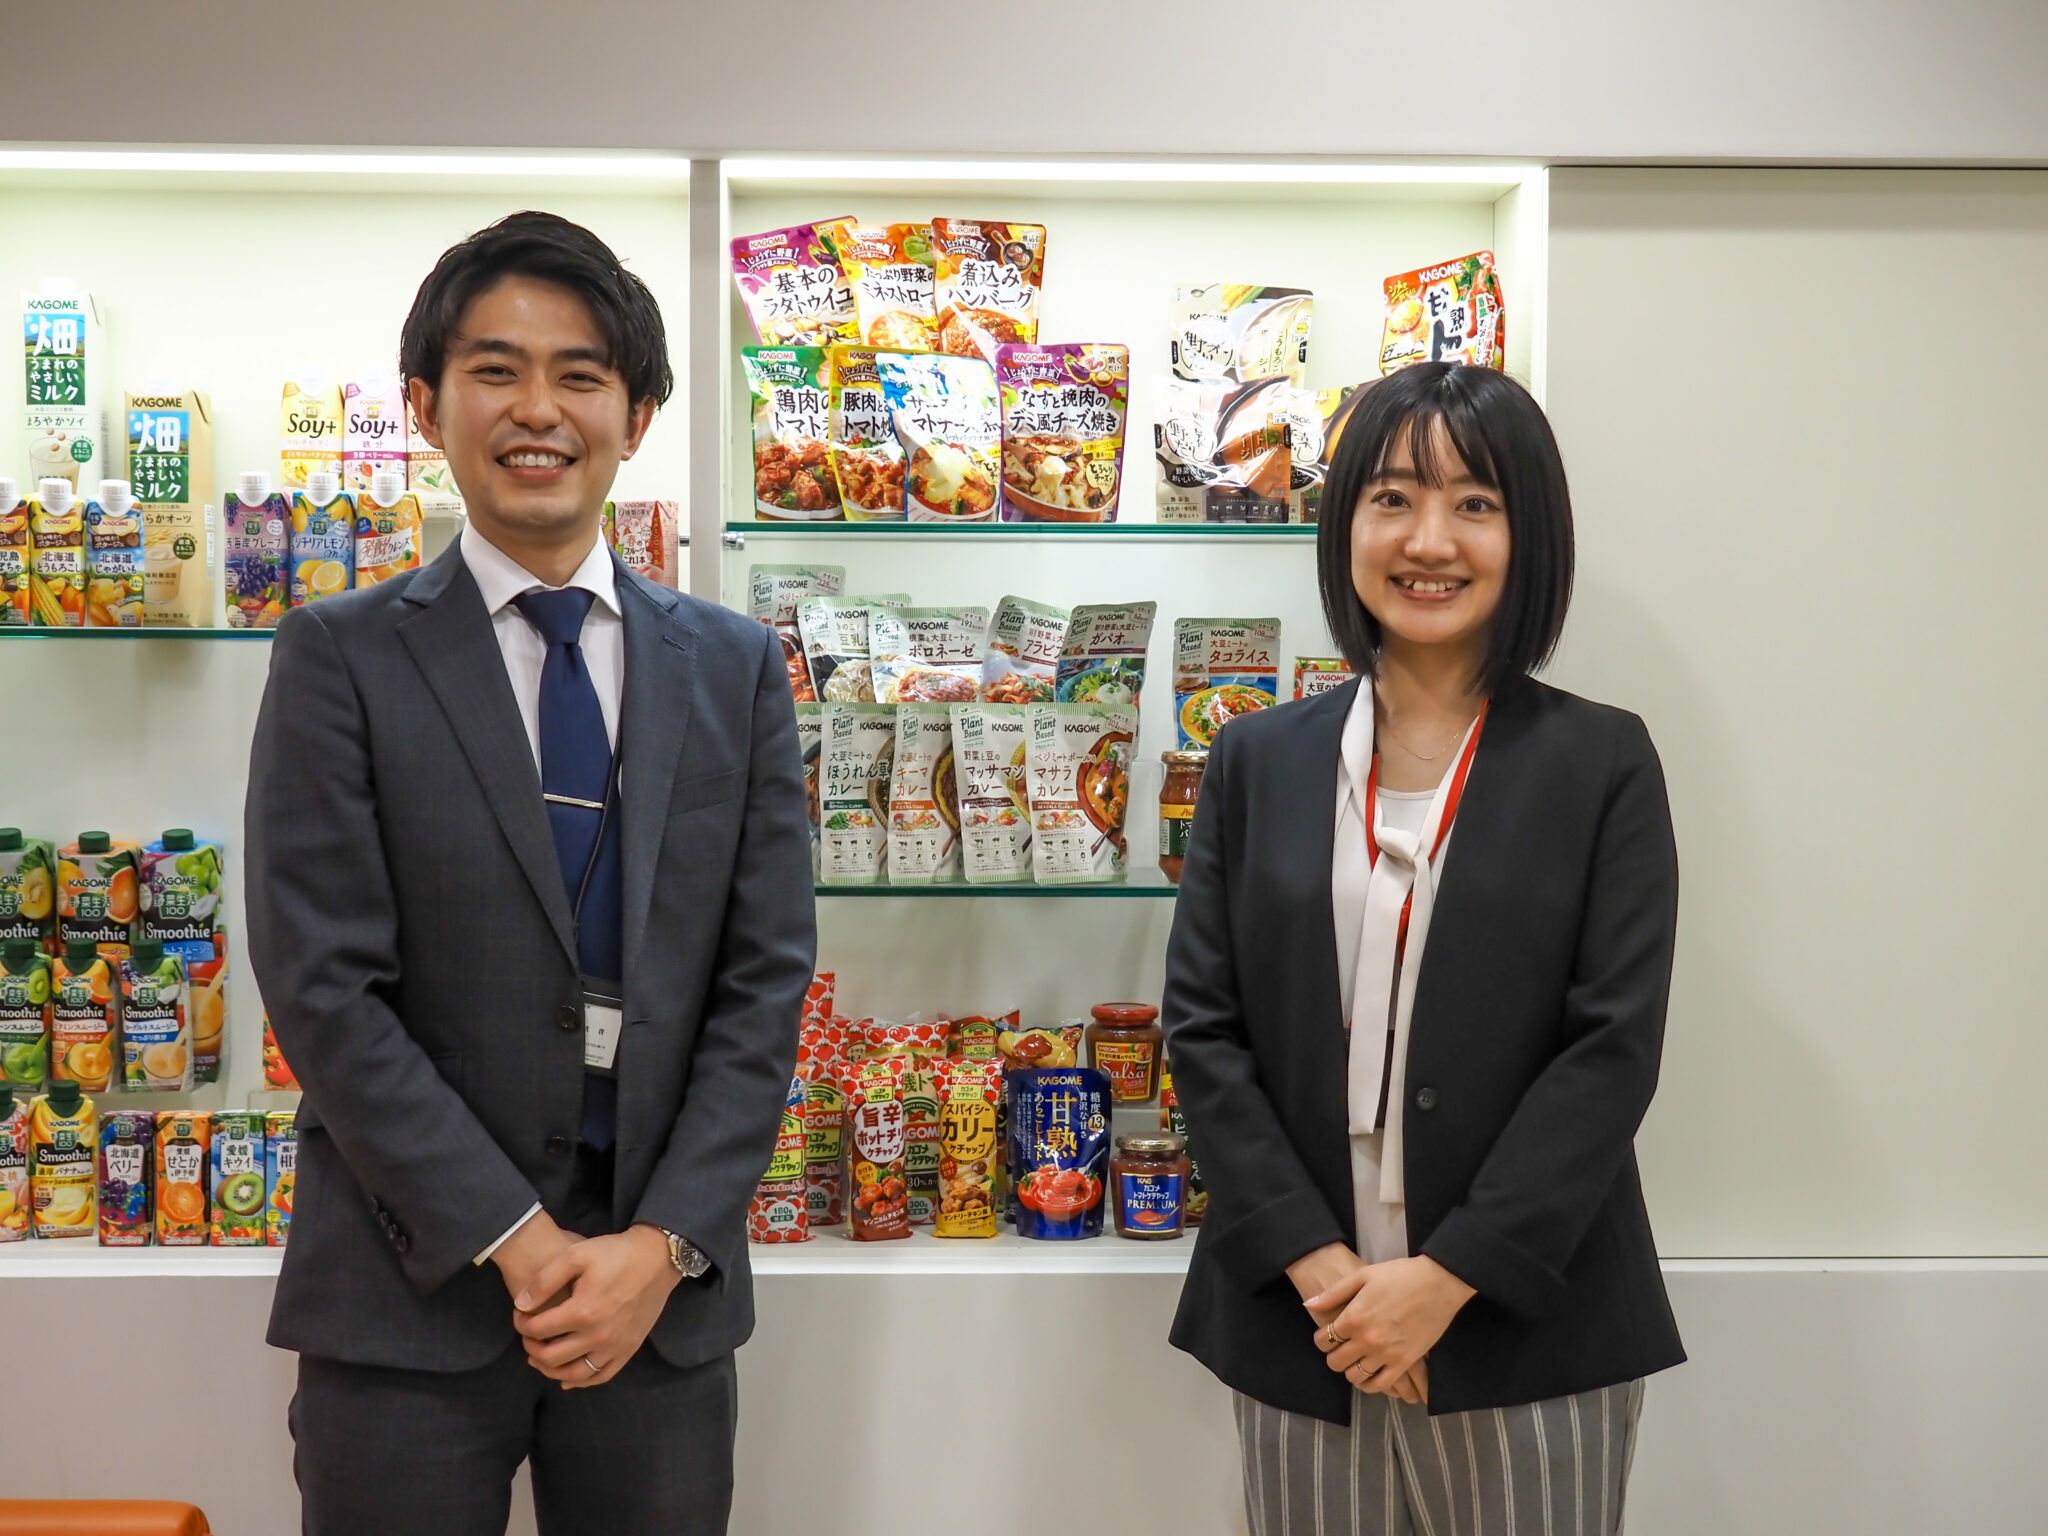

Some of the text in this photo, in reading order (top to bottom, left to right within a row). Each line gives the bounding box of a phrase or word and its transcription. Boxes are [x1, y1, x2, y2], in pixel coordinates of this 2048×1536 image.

[948, 225, 980, 235] KAGOME
[750, 235, 786, 249] KAGOME
[961, 262, 1020, 288] 煮込み
[1418, 262, 1464, 283] KAGOME
[775, 267, 834, 294] 基本の
[861, 281, 934, 305] ミネストロー
[948, 287, 1034, 308] ハンバーグ
[28, 300, 78, 310] KAGOME
[30, 315, 78, 356] 畑
[759, 352, 795, 360] KAGOME
[1014, 354, 1052, 362] KAGOME
[31, 359, 78, 370] うまれの
[30, 372, 79, 383] やさしい
[31, 385, 79, 401] ミルク
[1021, 388, 1106, 409] なすと挽肉の
[132, 398, 182, 408] KAGOME
[287, 413, 337, 439] Soy+
[775, 412, 829, 438] トマト
[1010, 408, 1118, 432] デミ風チーズ焼き
[349, 414, 399, 439] Soy+
[134, 413, 181, 454] 畑
[135, 457, 181, 468] うまれの
[135, 470, 182, 481] やさしい
[135, 483, 182, 498] ミルク
[143, 515, 192, 525] らかオーツ
[43, 552, 75, 562] 北海道
[100, 553, 133, 564] 北海道
[37, 562, 81, 573] とうもろこし
[95, 564, 137, 574] じゃがいも
[753, 583, 773, 598] Plant
[779, 580, 809, 589] KAGOME
[754, 596, 772, 606] Based
[1000, 611, 1026, 624] Plant
[1072, 616, 1093, 630] Plant
[1097, 613, 1125, 621] KAGOME
[908, 621, 949, 630] KAGOME
[999, 622, 1022, 632] Based
[1030, 616, 1063, 631] KAGOME
[1089, 632, 1125, 645] ガパオ
[1179, 631, 1204, 644] Plant
[1210, 639, 1249, 648] 大豆ミートの
[908, 644, 976, 659] ボロネーゼ
[1180, 643, 1202, 653] Based
[1209, 648, 1270, 664] タコライス
[1315, 674, 1347, 682] KAGOME
[832, 717, 853, 731] Plant
[859, 722, 896, 731] KAGOME
[902, 717, 919, 731] Plant
[960, 716, 984, 730] Plant
[991, 723, 1024, 733] KAGOME
[1033, 718, 1056, 731] Plant
[1064, 723, 1100, 733] KAGOME
[833, 729, 853, 739] Based
[963, 729, 984, 739] Based
[1035, 729, 1055, 740] Based
[829, 751, 873, 761] 大豆ミートの
[963, 750, 1001, 761] 野菜と豆の
[1034, 752, 1096, 763] ベジミートボールの
[827, 762, 891, 781] ほうれん草
[896, 766, 929, 778] キーマ
[965, 764, 1026, 779] マッサマン
[1033, 765, 1073, 781] マサラ
[828, 782, 864, 797] カレー
[896, 784, 929, 797] カレー
[967, 782, 1003, 796] カレー
[1036, 784, 1074, 797] カレー
[68, 879, 113, 888] KAGOME
[153, 877, 197, 886] KAGOME
[70, 896, 112, 907] 野菜生活
[153, 895, 197, 907] 野菜生活
[80, 908, 101, 917] 100
[165, 906, 186, 916] 100
[61, 924, 127, 941] Smoothie
[146, 922, 211, 939] Smoothie
[0, 1006, 42, 1018] moothie
[55, 1004, 104, 1018] Smoothie
[125, 1005, 175, 1019] Smoothie
[1101, 1060, 1145, 1079] Salsa
[863, 1079, 893, 1087] KAGOME
[951, 1076, 985, 1085] KAGOME
[1037, 1076, 1083, 1086] KAGOME
[945, 1103, 990, 1116] スパイシー
[1079, 1091, 1089, 1139] 贅沢な甘さ
[804, 1114, 843, 1128] GOME
[862, 1104, 901, 1128] 旨辛
[942, 1118, 994, 1142] カリー
[1045, 1091, 1078, 1159] 甘熟
[857, 1128, 904, 1146] ホットチリ
[110, 1148, 140, 1158] 北海道
[227, 1145, 249, 1156] 愛媛
[867, 1144, 900, 1158] ケチャップ
[907, 1144, 929, 1156] カゴメ
[949, 1143, 986, 1154] ケチャップ
[39, 1149, 91, 1162] Smoothie
[110, 1160, 140, 1174] ベリー
[167, 1156, 199, 1169] せとか
[223, 1157, 251, 1168] キウイ
[1143, 1184, 1161, 1192] カゴメ
[1133, 1191, 1170, 1200] トマトケチャップ
[1127, 1199, 1177, 1209] PREMIUM
